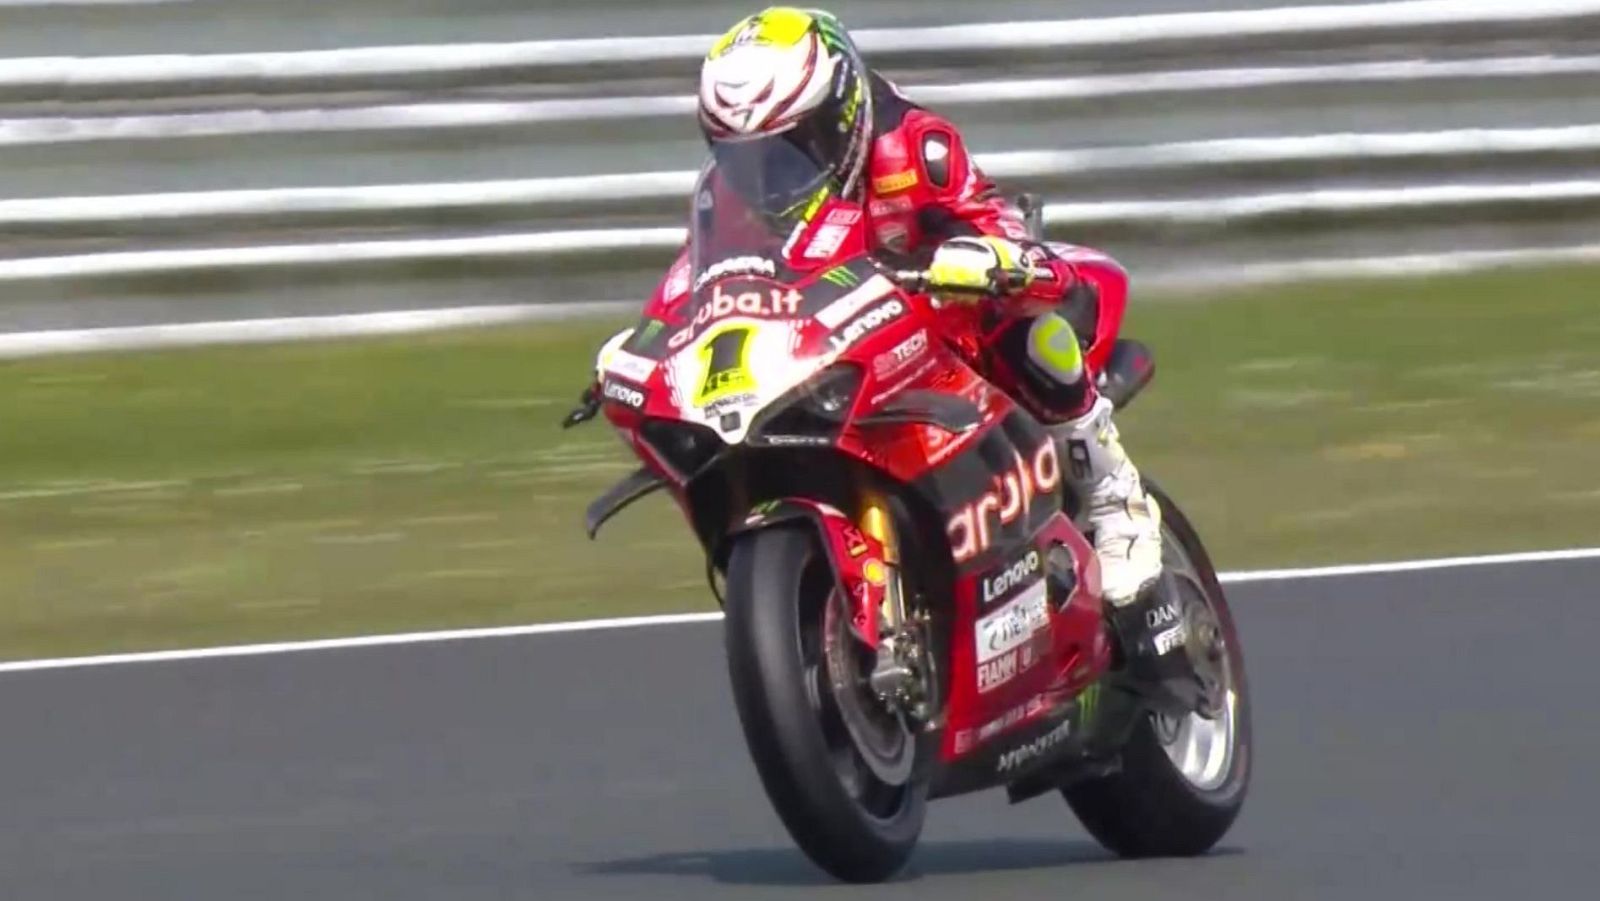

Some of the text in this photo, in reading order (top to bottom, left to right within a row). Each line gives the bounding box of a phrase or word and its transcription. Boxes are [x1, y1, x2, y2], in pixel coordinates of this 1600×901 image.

[668, 286, 803, 347] aruba.it
[828, 299, 903, 352] Lenovo
[703, 327, 750, 397] 1
[983, 551, 1039, 602] Lenovo
